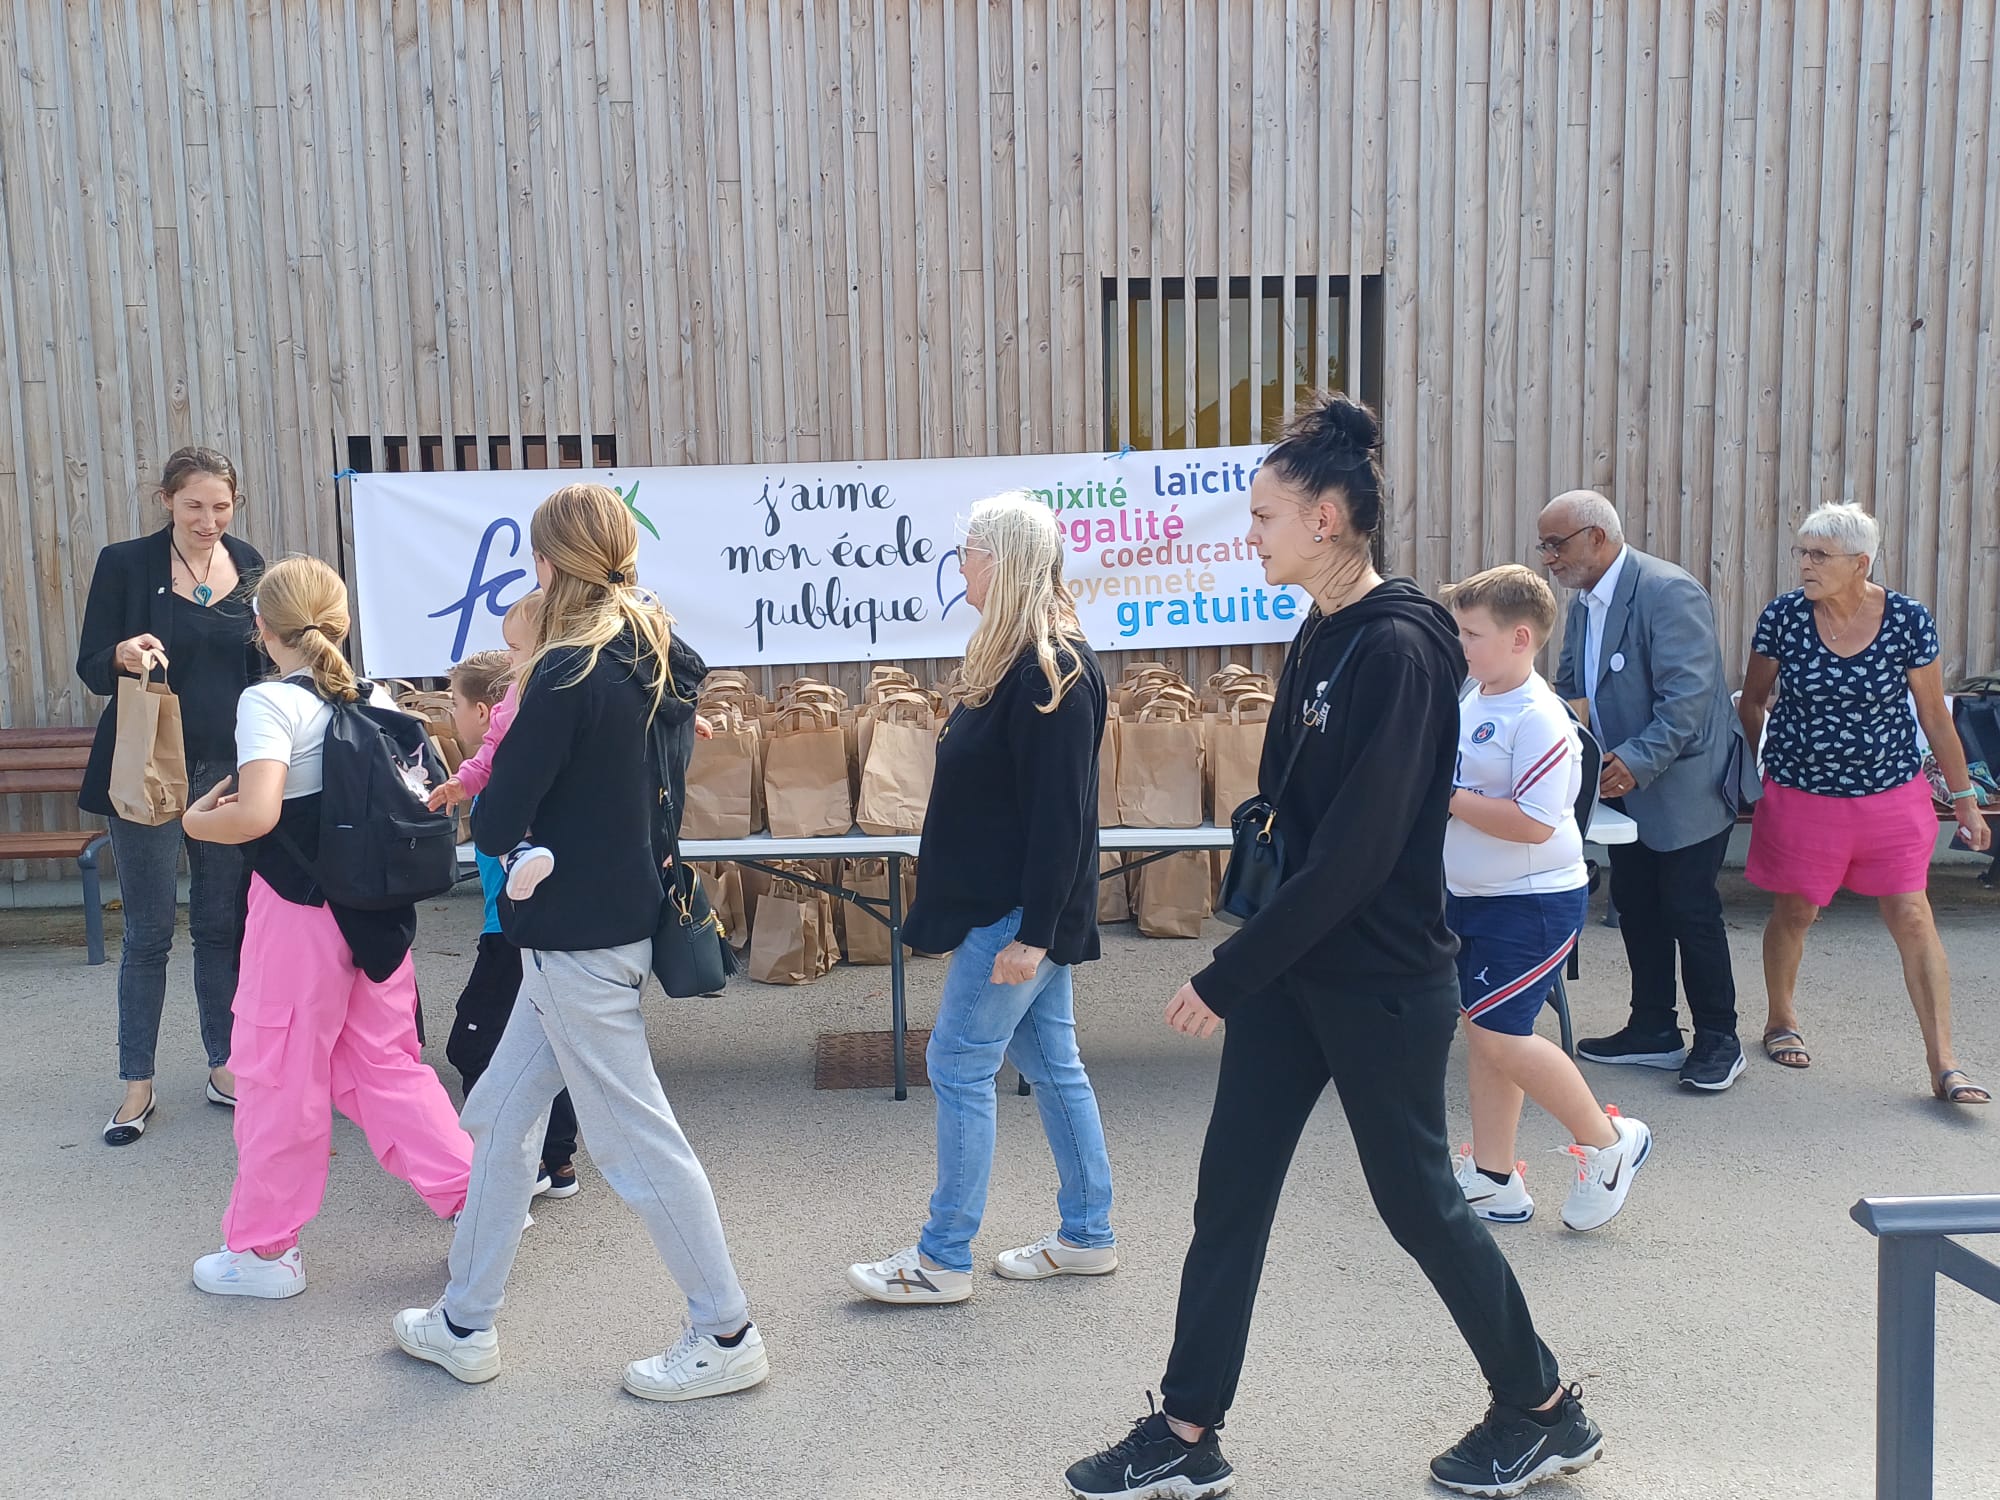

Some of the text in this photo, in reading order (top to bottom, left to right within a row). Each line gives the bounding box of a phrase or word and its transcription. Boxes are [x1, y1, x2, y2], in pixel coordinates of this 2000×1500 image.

[753, 476, 897, 537] j'aime
[720, 515, 936, 574] mon école
[1100, 537, 1259, 568] coéducati
[1066, 563, 1216, 604] oyenneté
[1116, 584, 1296, 637] gratuité
[744, 576, 928, 652] publique
